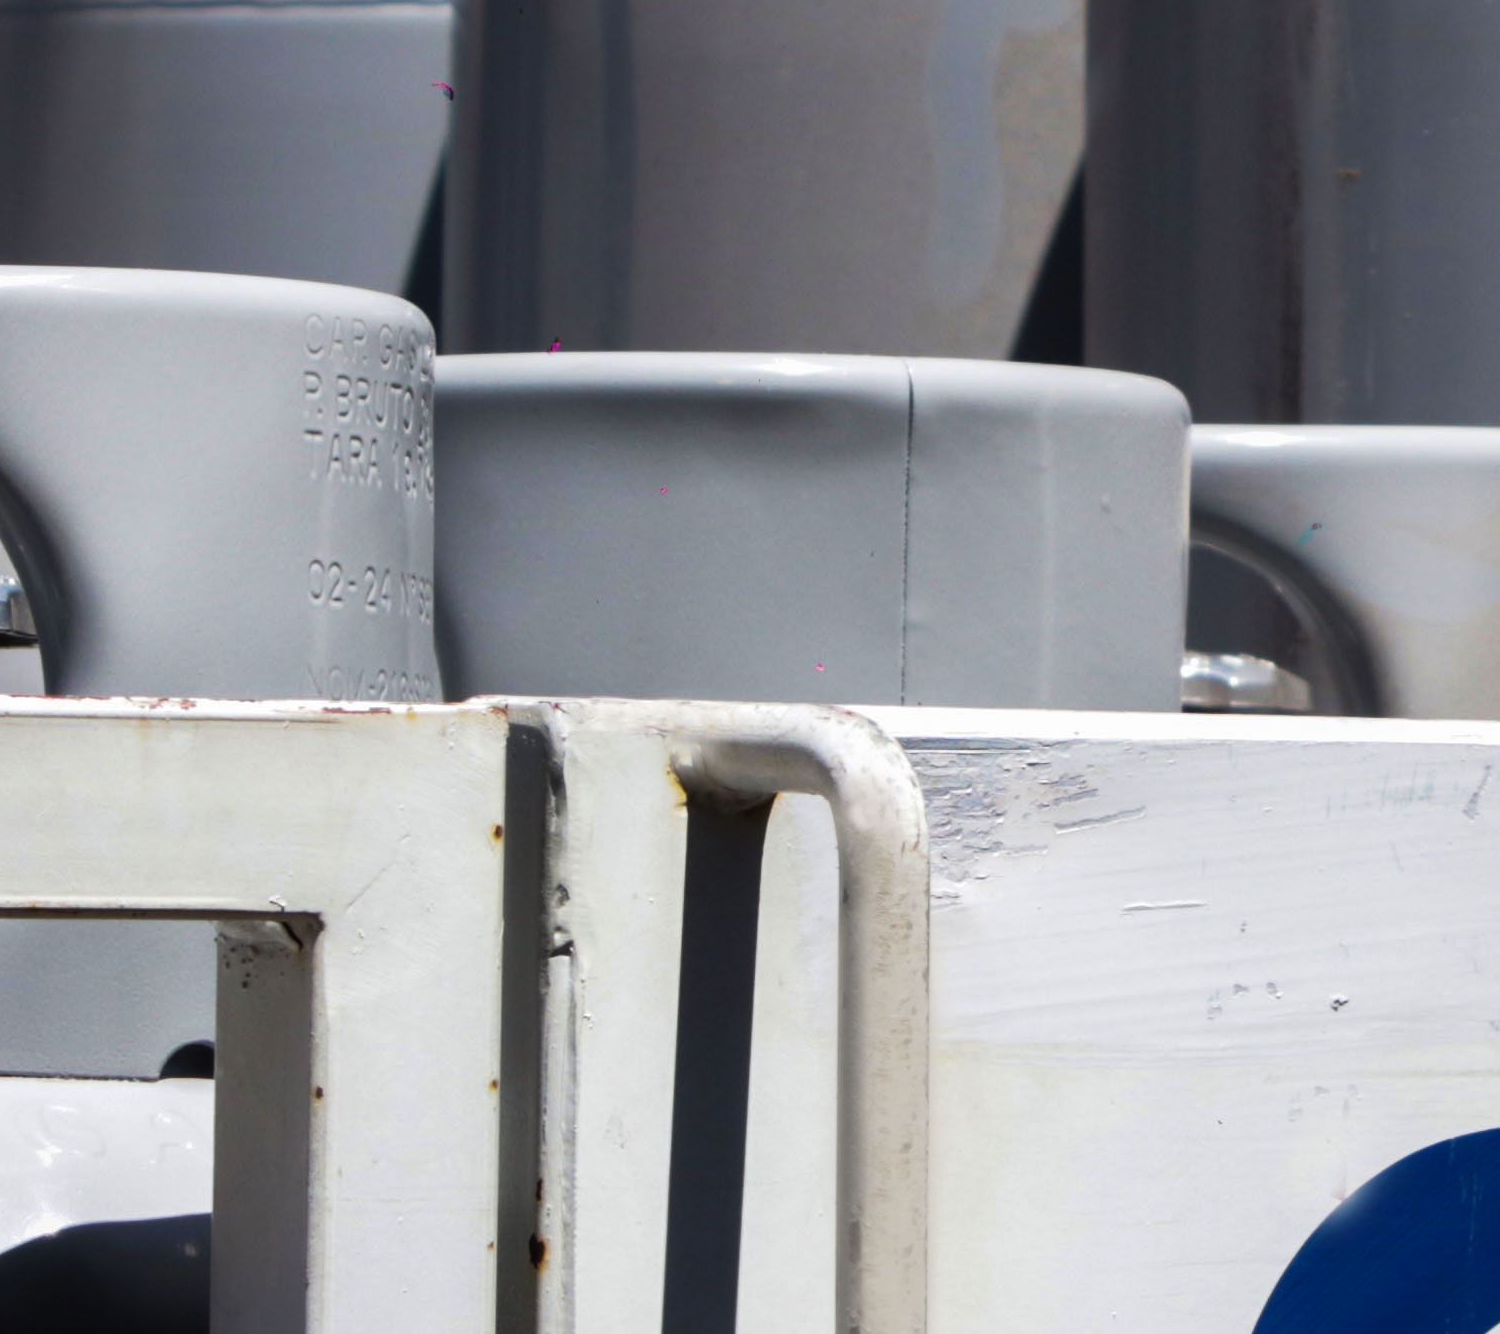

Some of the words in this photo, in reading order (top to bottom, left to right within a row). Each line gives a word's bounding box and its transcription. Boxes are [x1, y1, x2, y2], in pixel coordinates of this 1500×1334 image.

[304, 312, 368, 365] CAP.
[303, 370, 324, 419] P.
[336, 373, 415, 435] BRUTO
[303, 429, 383, 490] TARA
[308, 558, 393, 613] 02-24
